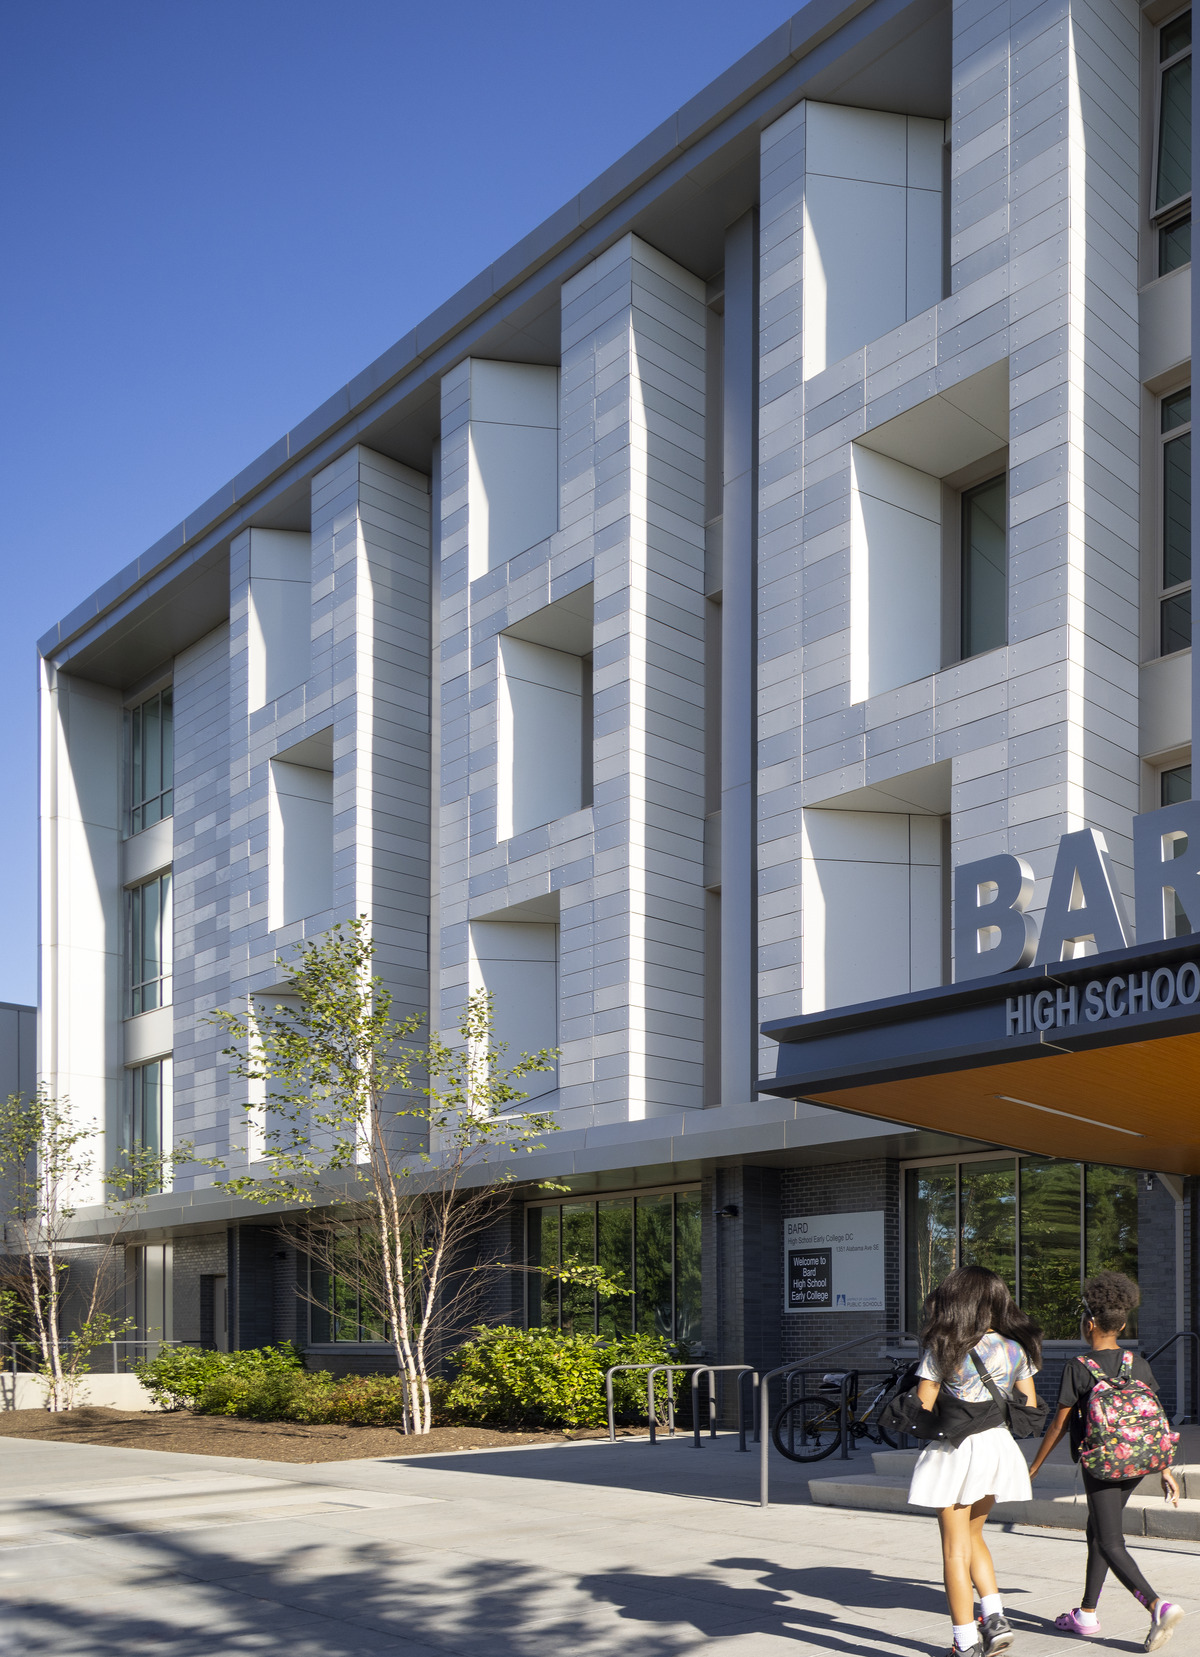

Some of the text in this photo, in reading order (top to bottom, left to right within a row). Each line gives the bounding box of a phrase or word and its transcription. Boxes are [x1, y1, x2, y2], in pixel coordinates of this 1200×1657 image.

[1005, 985, 1079, 1037] HIGH
[788, 1223, 808, 1234] BARD
[798, 1236, 813, 1244] School
[813, 1235, 825, 1244] Early
[826, 1234, 844, 1243] College
[793, 1256, 827, 1266] Welcome to
[803, 1267, 816, 1277] Bard
[793, 1277, 827, 1290] High School
[791, 1290, 829, 1303] Early College
